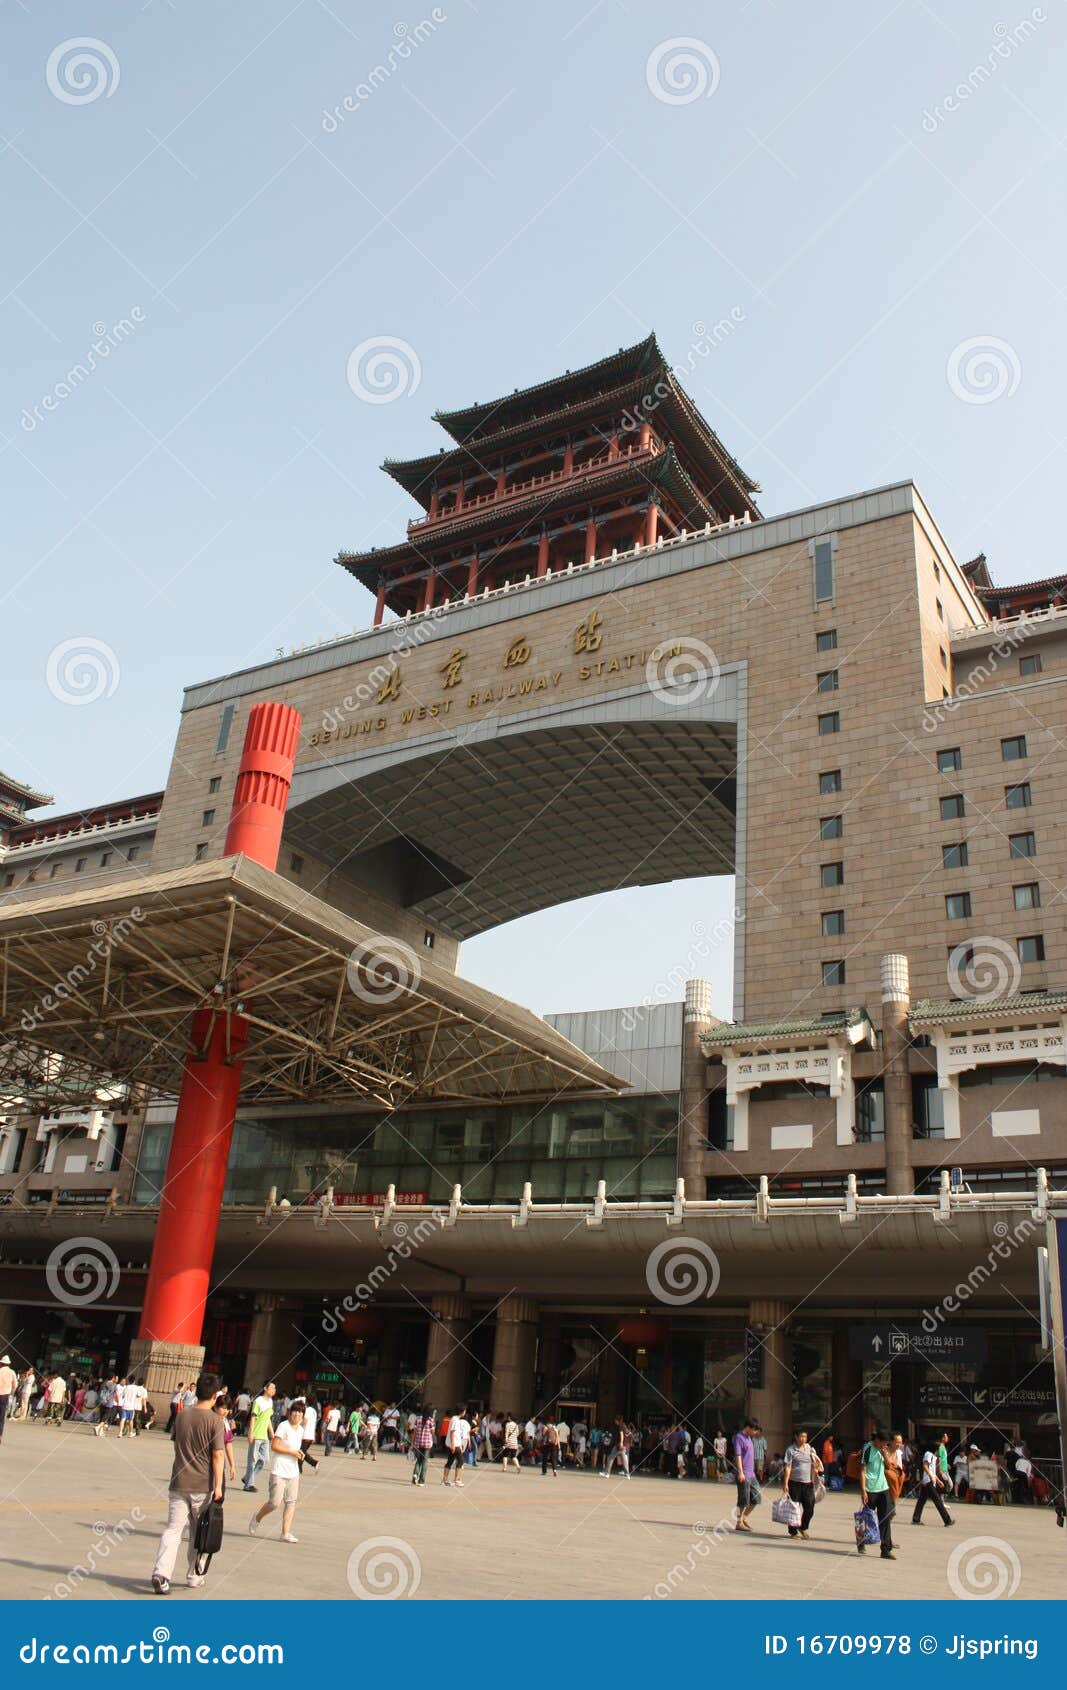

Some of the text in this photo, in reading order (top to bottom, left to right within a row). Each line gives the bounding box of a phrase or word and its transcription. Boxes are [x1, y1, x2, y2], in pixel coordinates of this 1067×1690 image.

[310, 641, 682, 746] BEIJING WEST RAILWAY STATION
[376, 611, 602, 704] 北京西站
